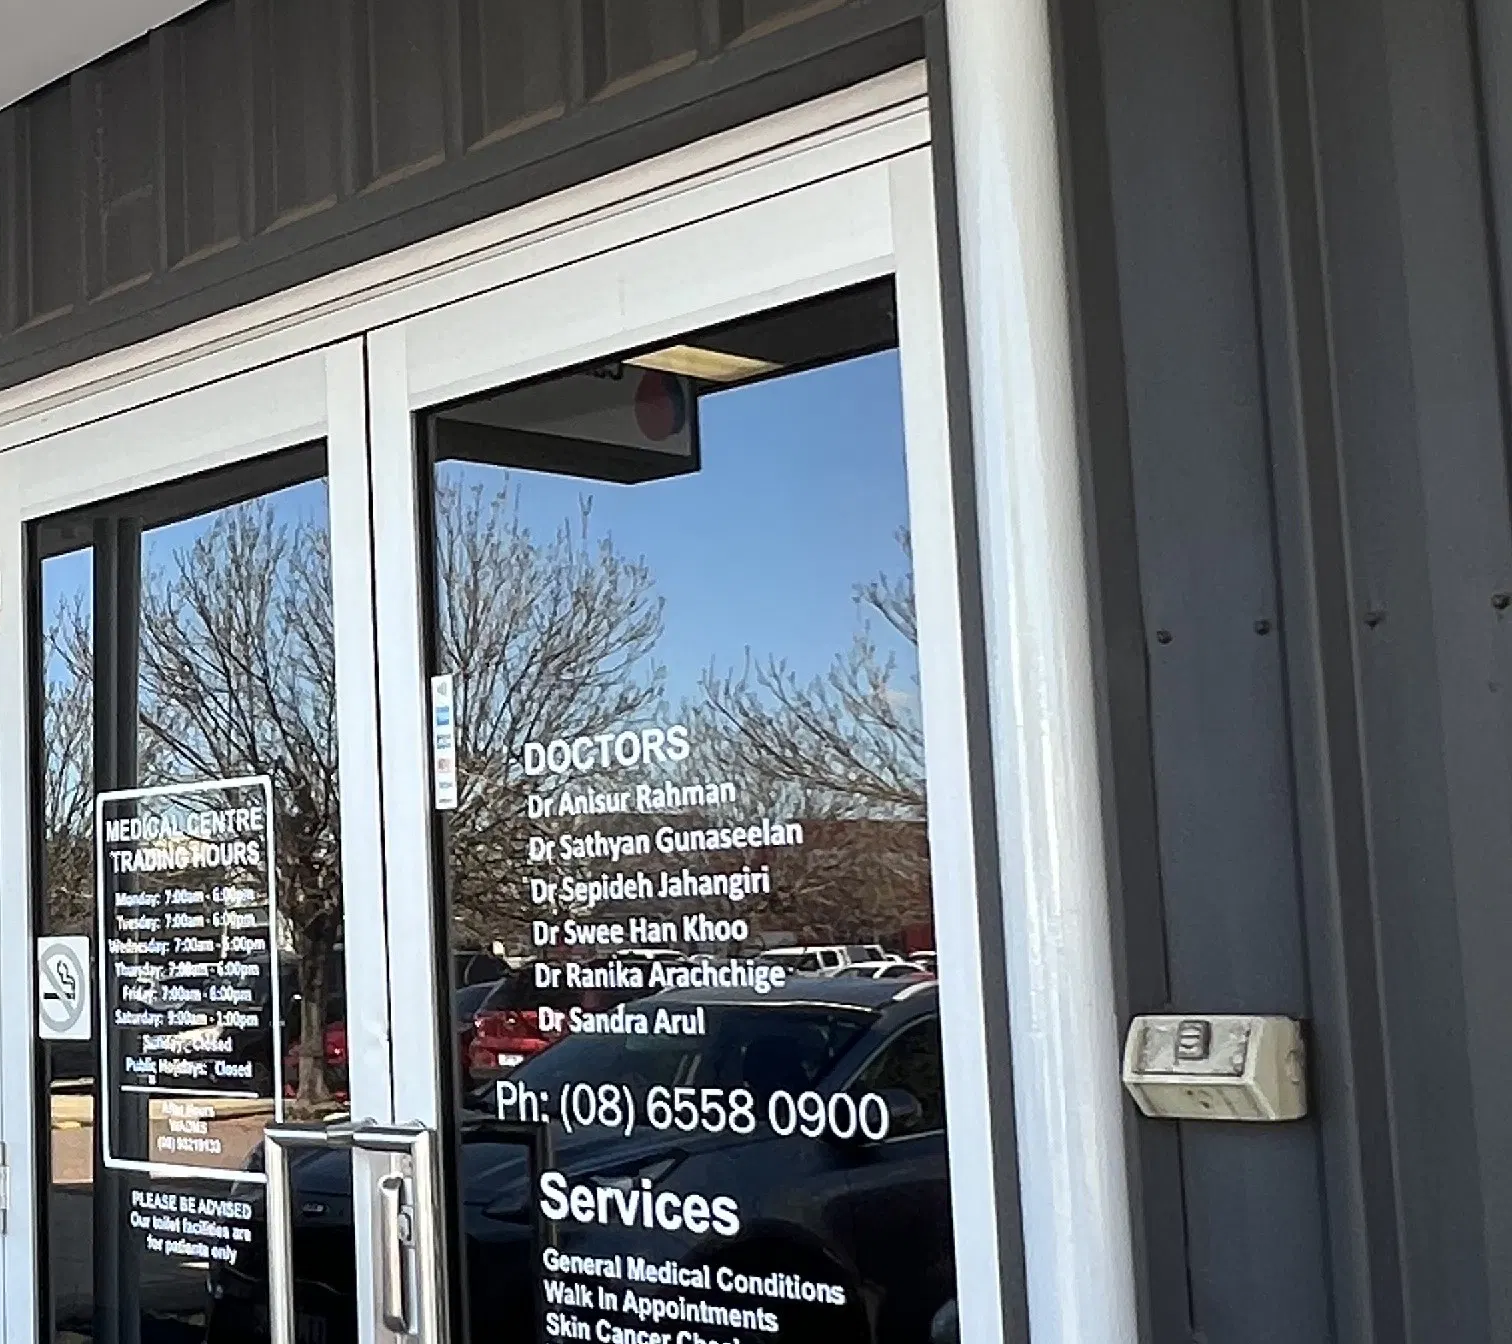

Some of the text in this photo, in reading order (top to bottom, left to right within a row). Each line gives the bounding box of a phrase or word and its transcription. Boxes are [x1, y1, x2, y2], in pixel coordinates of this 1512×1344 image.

[524, 724, 690, 776] DOCTORS
[528, 780, 736, 819] Dr Anisur Rahman
[106, 808, 263, 842] MEDICAL CENTRE
[529, 817, 804, 863] Dr Sathyan Gunaseelan
[109, 840, 261, 874] TRADING HOURS
[530, 865, 771, 908] Dr Sepideh Jahangiri
[532, 912, 749, 947] Dr Swee Han Khoo
[534, 958, 787, 994] Dr Ranika Arachchige
[538, 1003, 706, 1034] Dr Sandra Arul
[215, 1060, 253, 1078] Closed
[496, 1080, 889, 1140] Ph: (08) 6558 0900
[132, 1190, 252, 1220] PLEASE BE ADVISED
[539, 1171, 741, 1236] Services
[130, 1211, 151, 1228] Our
[232, 1227, 252, 1242] are
[211, 1245, 238, 1265] only
[543, 1247, 846, 1305] General Medical Conditions
[544, 1279, 779, 1333] Walk In Appointments
[546, 1312, 591, 1344] Skin
